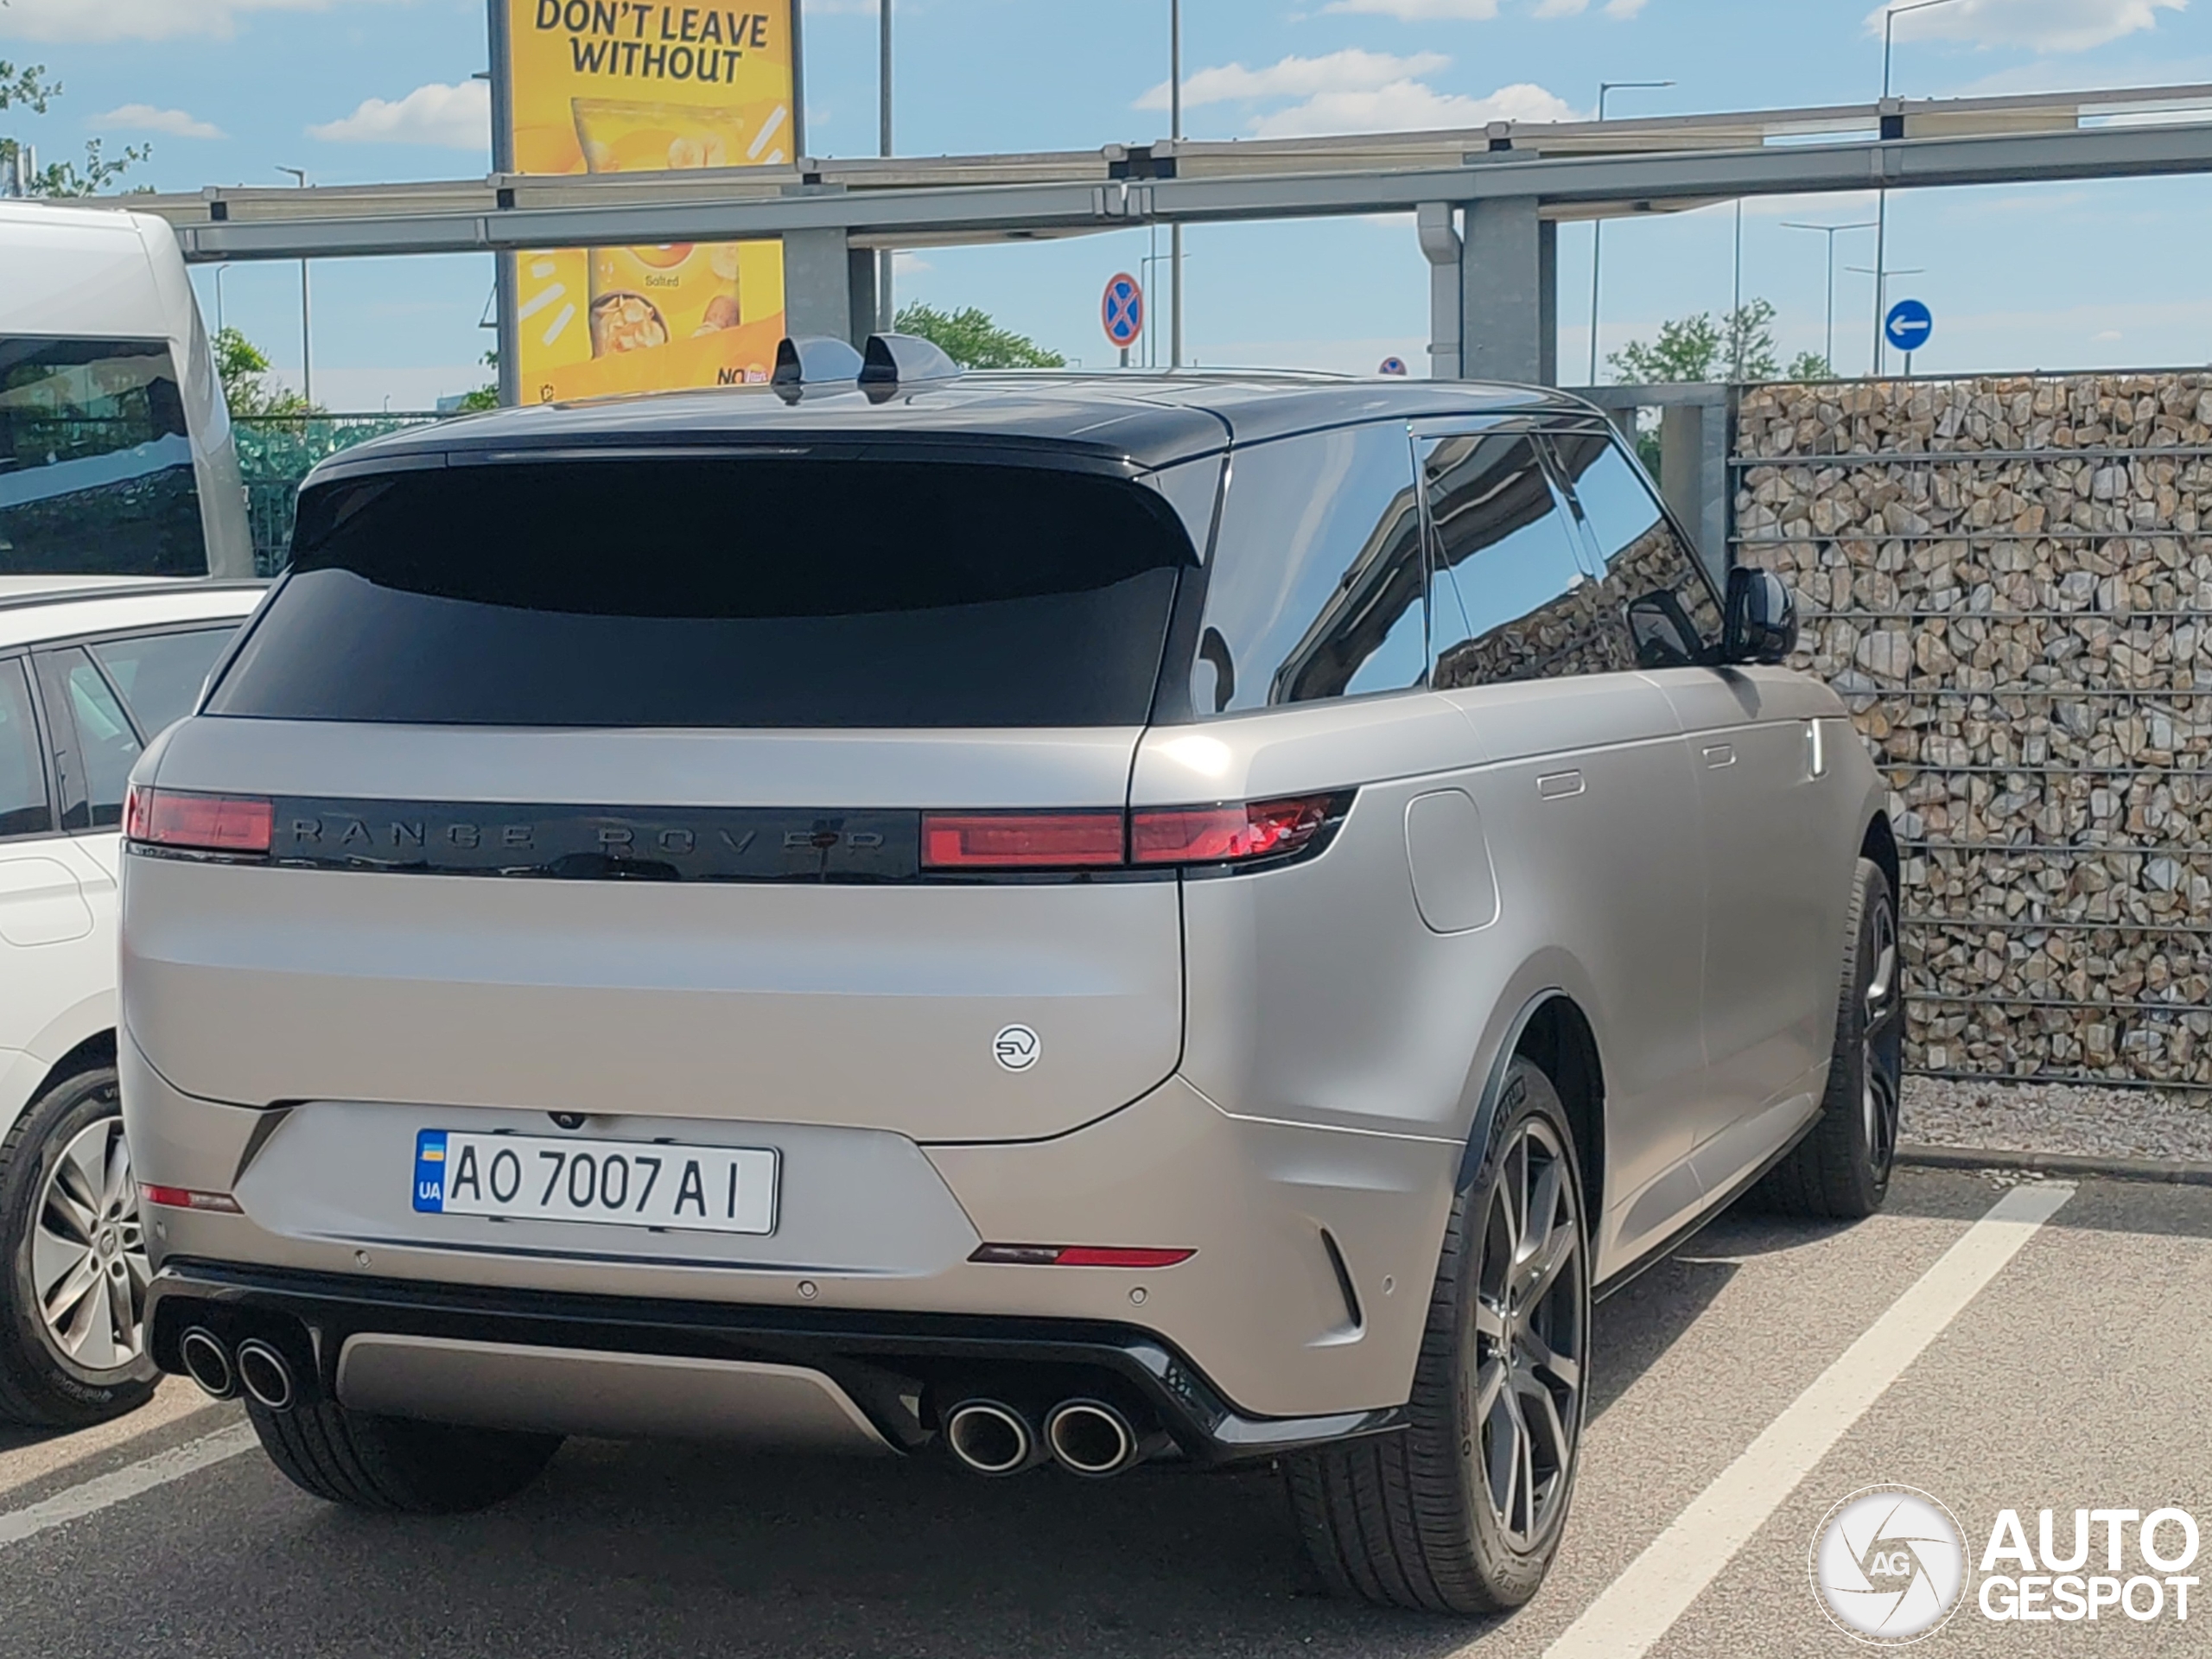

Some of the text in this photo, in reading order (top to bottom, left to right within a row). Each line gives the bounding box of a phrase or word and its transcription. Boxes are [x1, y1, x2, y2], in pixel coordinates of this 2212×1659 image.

[536, 0, 769, 48] DON'T LEAVE
[569, 37, 742, 84] WITHOUT
[645, 275, 679, 287] Salted
[293, 819, 886, 855] RANGE ROVER
[419, 1182, 442, 1201] UA
[539, 1151, 662, 1210] 7007
